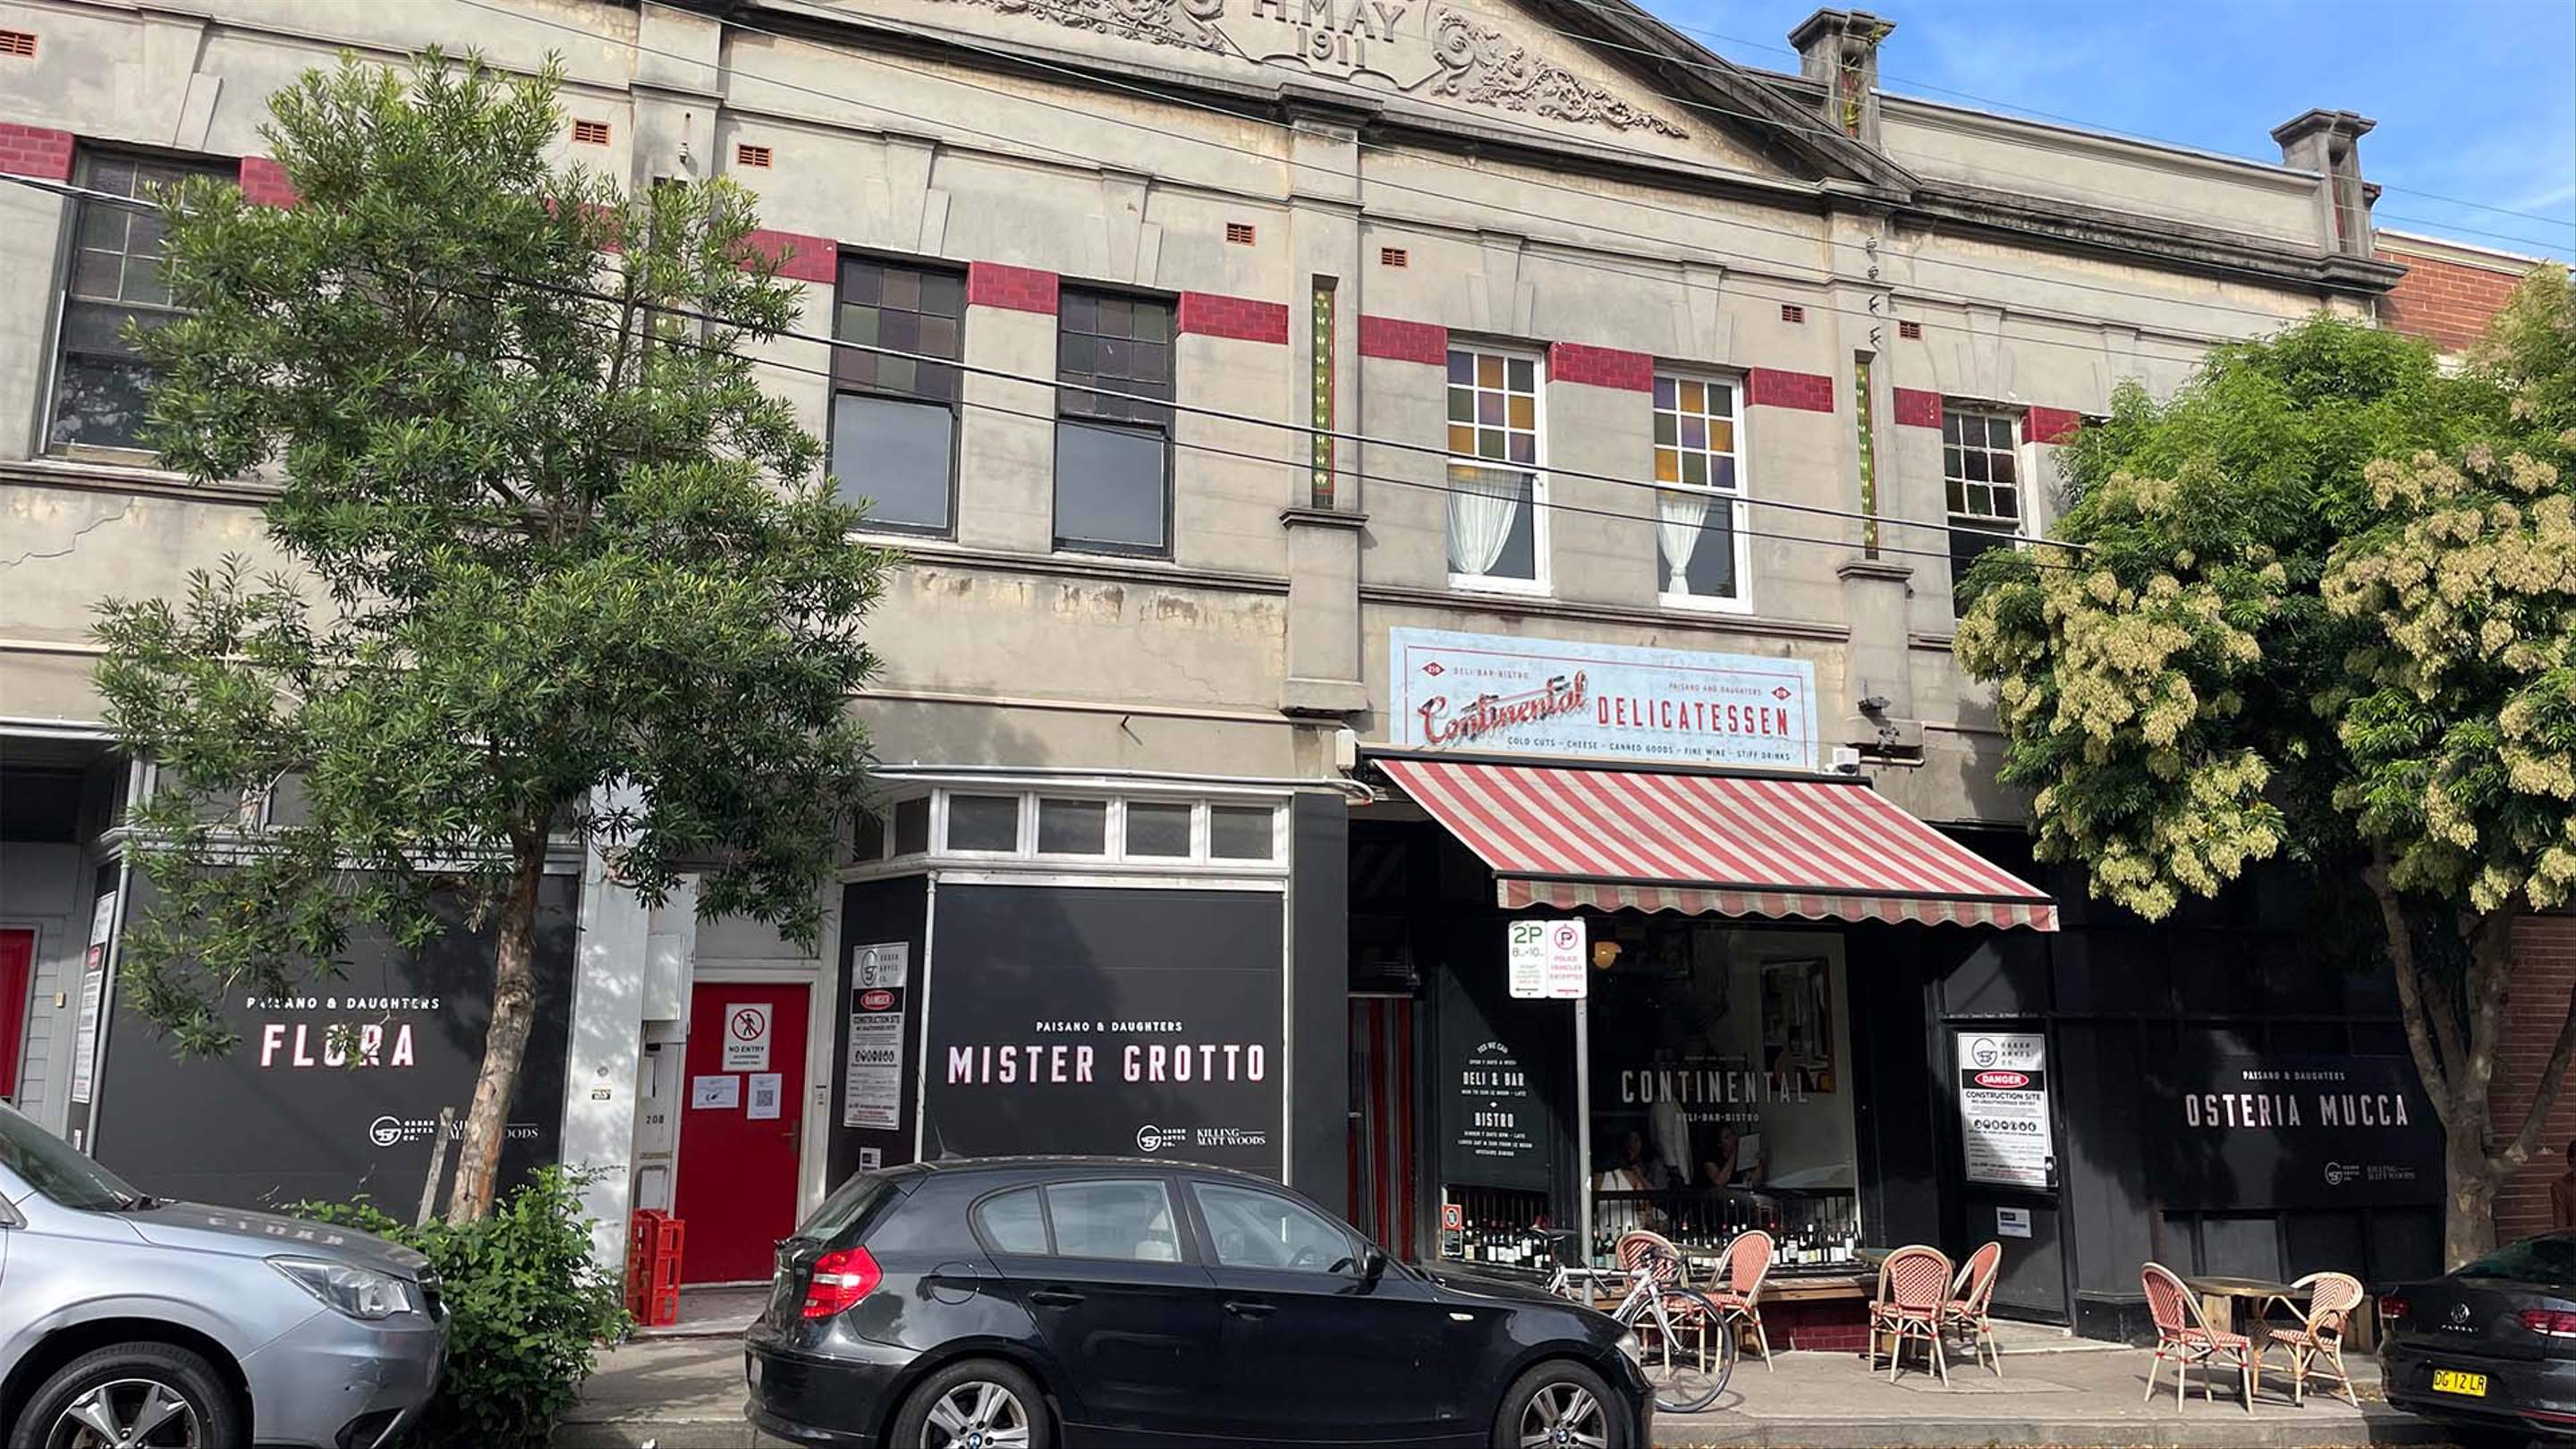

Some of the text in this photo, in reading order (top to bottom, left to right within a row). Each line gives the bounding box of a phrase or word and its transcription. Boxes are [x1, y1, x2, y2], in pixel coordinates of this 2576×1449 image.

[1297, 27, 1366, 69] 1911
[1417, 669, 1589, 744] Continental
[1597, 696, 1788, 736] DELICATESSEN
[1507, 736, 1790, 761] COLD CUTS CHEESE CANNED GOODS FINE WINE STIFF DRINKS
[1513, 926, 1543, 944] 2P
[326, 997, 336, 1009] &
[346, 997, 440, 1010] DAUGHTERS
[1036, 1021, 1183, 1032] PAISANO & DAUGHTERS
[260, 1023, 415, 1066] FLORA
[947, 1044, 1266, 1084] MISTER GROTTO
[1462, 1072, 1524, 1087] DELI & BAR
[1981, 1074, 2022, 1085] DANGER
[2242, 1071, 2280, 1080] PAISANO
[2294, 1072, 2345, 1080] DAUGHTERS
[1622, 1071, 1809, 1103] CONTINENTAL
[1966, 1090, 2041, 1101] CONSTRUCTION SITE
[2185, 1094, 2409, 1127] OSTERIA MUCCA
[646, 1114, 665, 1124] 208
[1475, 1112, 1514, 1128] BISTRO
[1196, 1128, 1240, 1137] KILLING
[1196, 1136, 1266, 1146] MATT WOODS
[2454, 1374, 2467, 1389] 12
